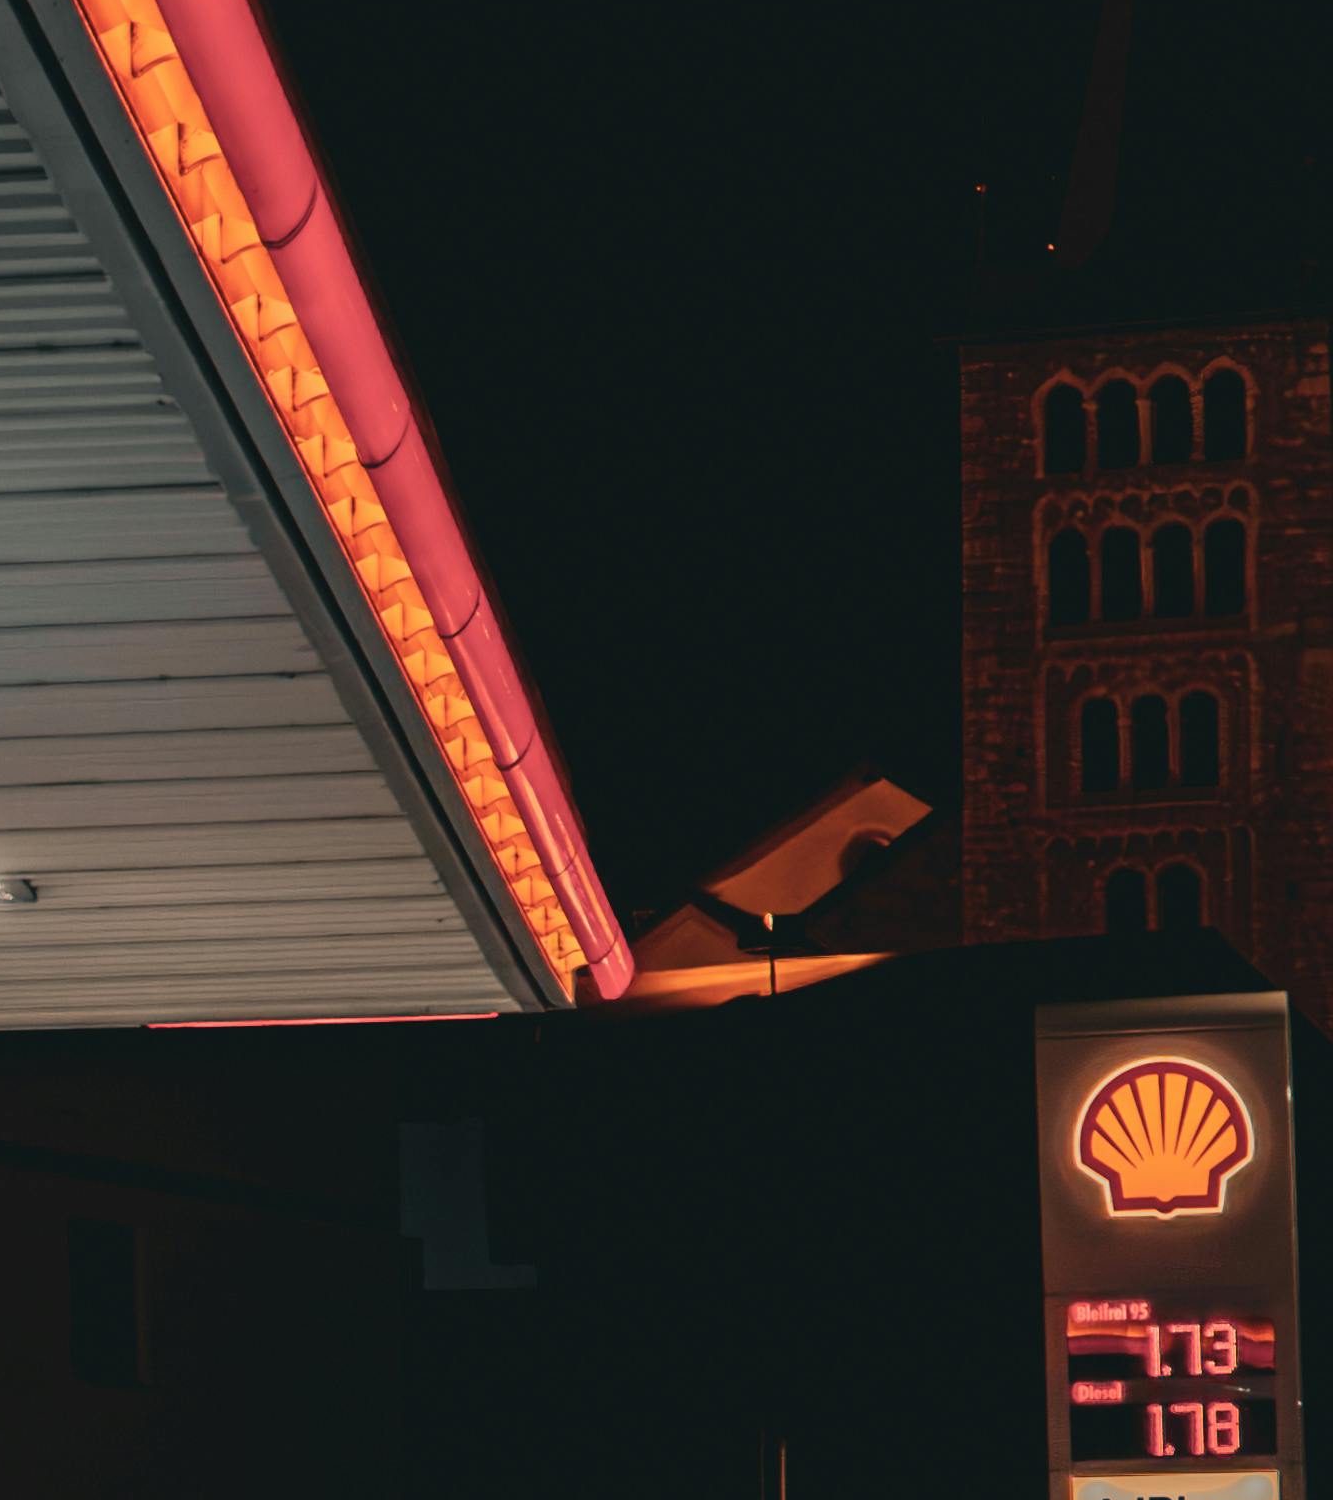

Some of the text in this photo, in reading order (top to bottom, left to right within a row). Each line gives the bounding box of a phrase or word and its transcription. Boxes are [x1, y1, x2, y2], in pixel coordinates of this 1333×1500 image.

[1129, 1302, 1149, 1320] 95
[1147, 1323, 1237, 1377] 1.73
[1077, 1383, 1123, 1401] Diesel
[1147, 1402, 1240, 1456] 1.78
